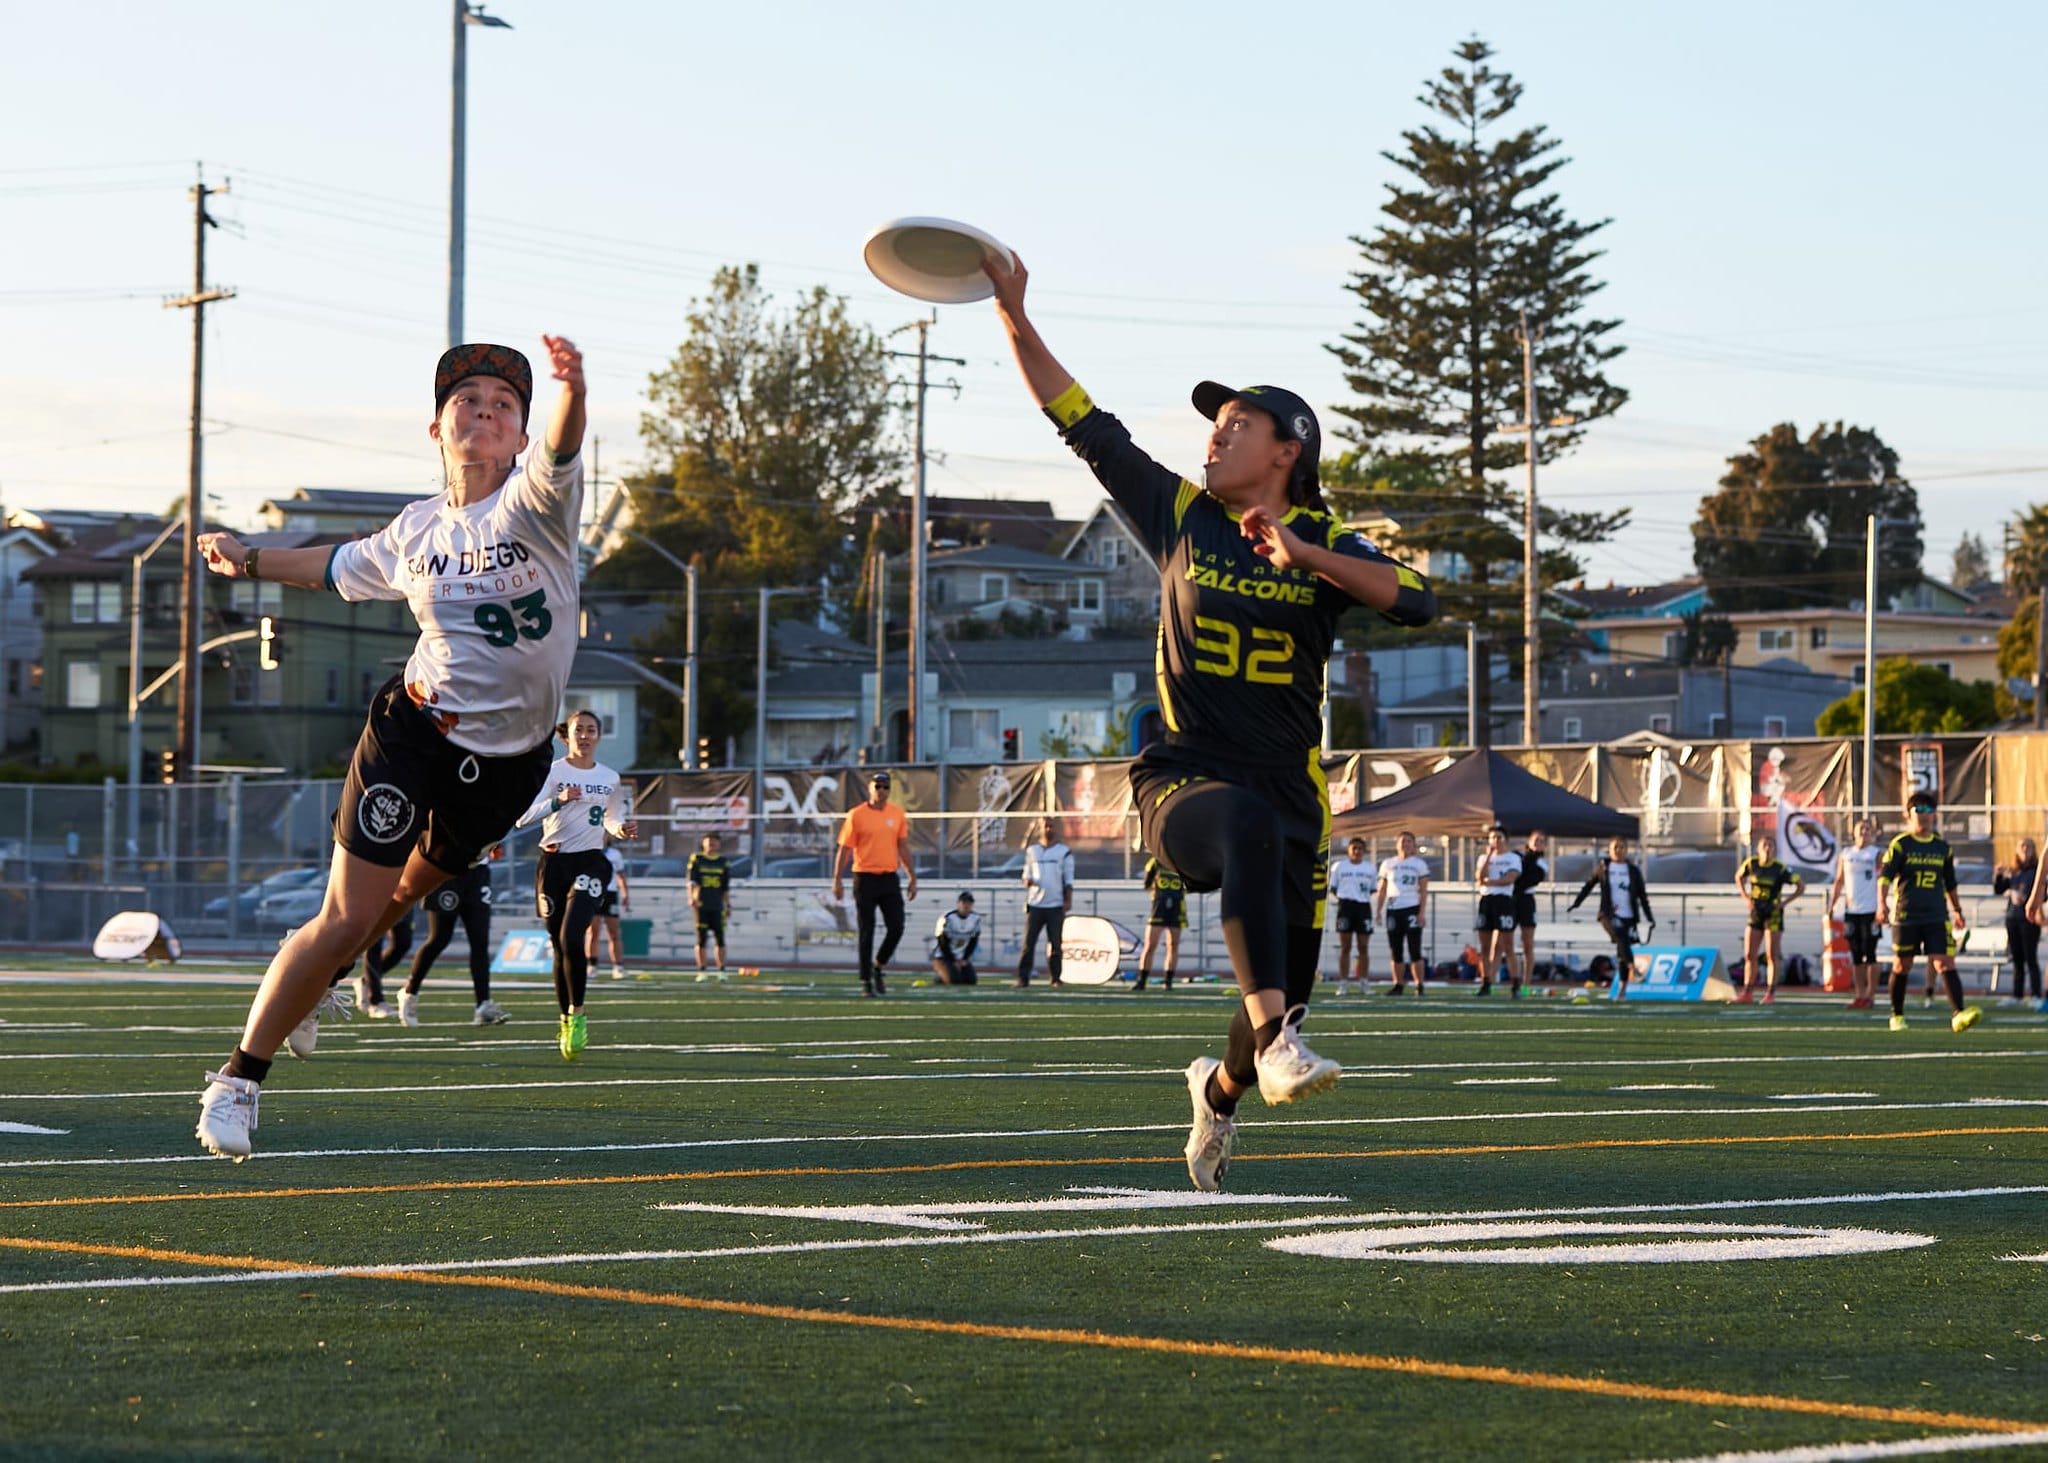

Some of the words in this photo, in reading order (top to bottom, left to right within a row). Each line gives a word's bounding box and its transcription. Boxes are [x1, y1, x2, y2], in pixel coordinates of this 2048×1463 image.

[408, 554, 448, 582] SAN
[458, 541, 529, 575] DIEGO
[464, 568, 539, 596] BLOOM
[1185, 564, 1315, 605] FALCONS
[473, 588, 553, 647] 93
[1195, 615, 1295, 685] 32
[588, 805, 606, 826] 9
[764, 776, 839, 826] PVC
[1915, 871, 1937, 888] 12
[1062, 947, 1112, 963] SCRAFT
